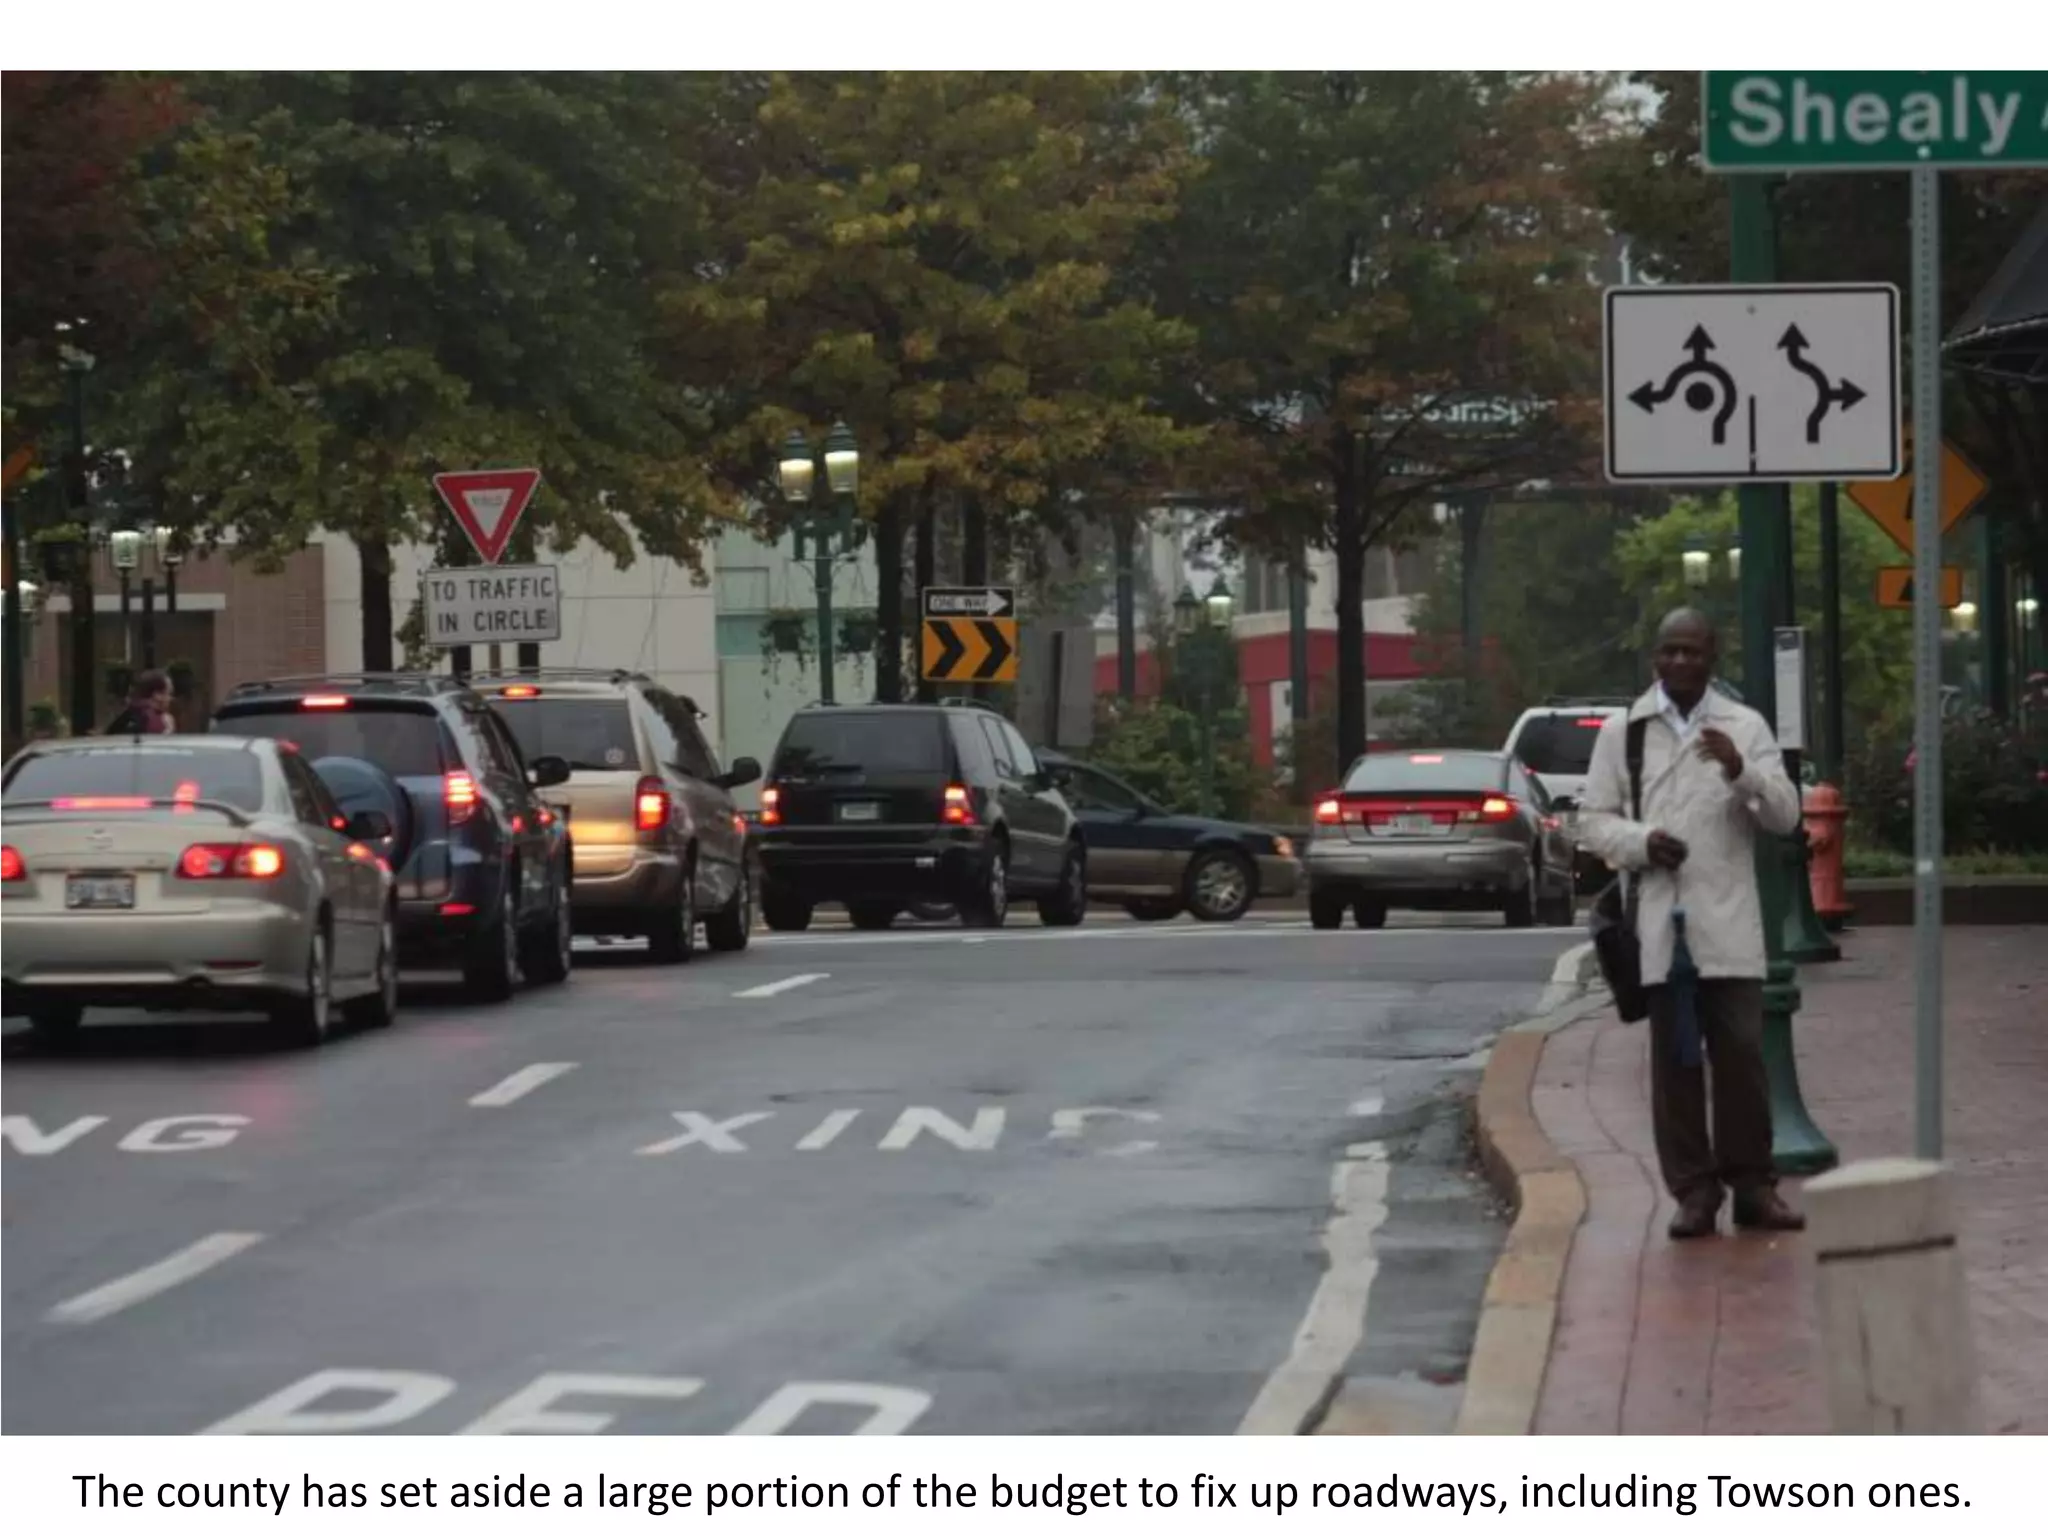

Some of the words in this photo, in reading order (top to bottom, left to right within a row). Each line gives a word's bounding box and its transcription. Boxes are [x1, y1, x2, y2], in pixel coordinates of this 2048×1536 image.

[1729, 76, 2022, 155] Shealy
[431, 580, 457, 600] TO
[468, 577, 552, 599] TRAFFIC
[437, 613, 459, 632] IN
[474, 609, 548, 631] CIRCLE
